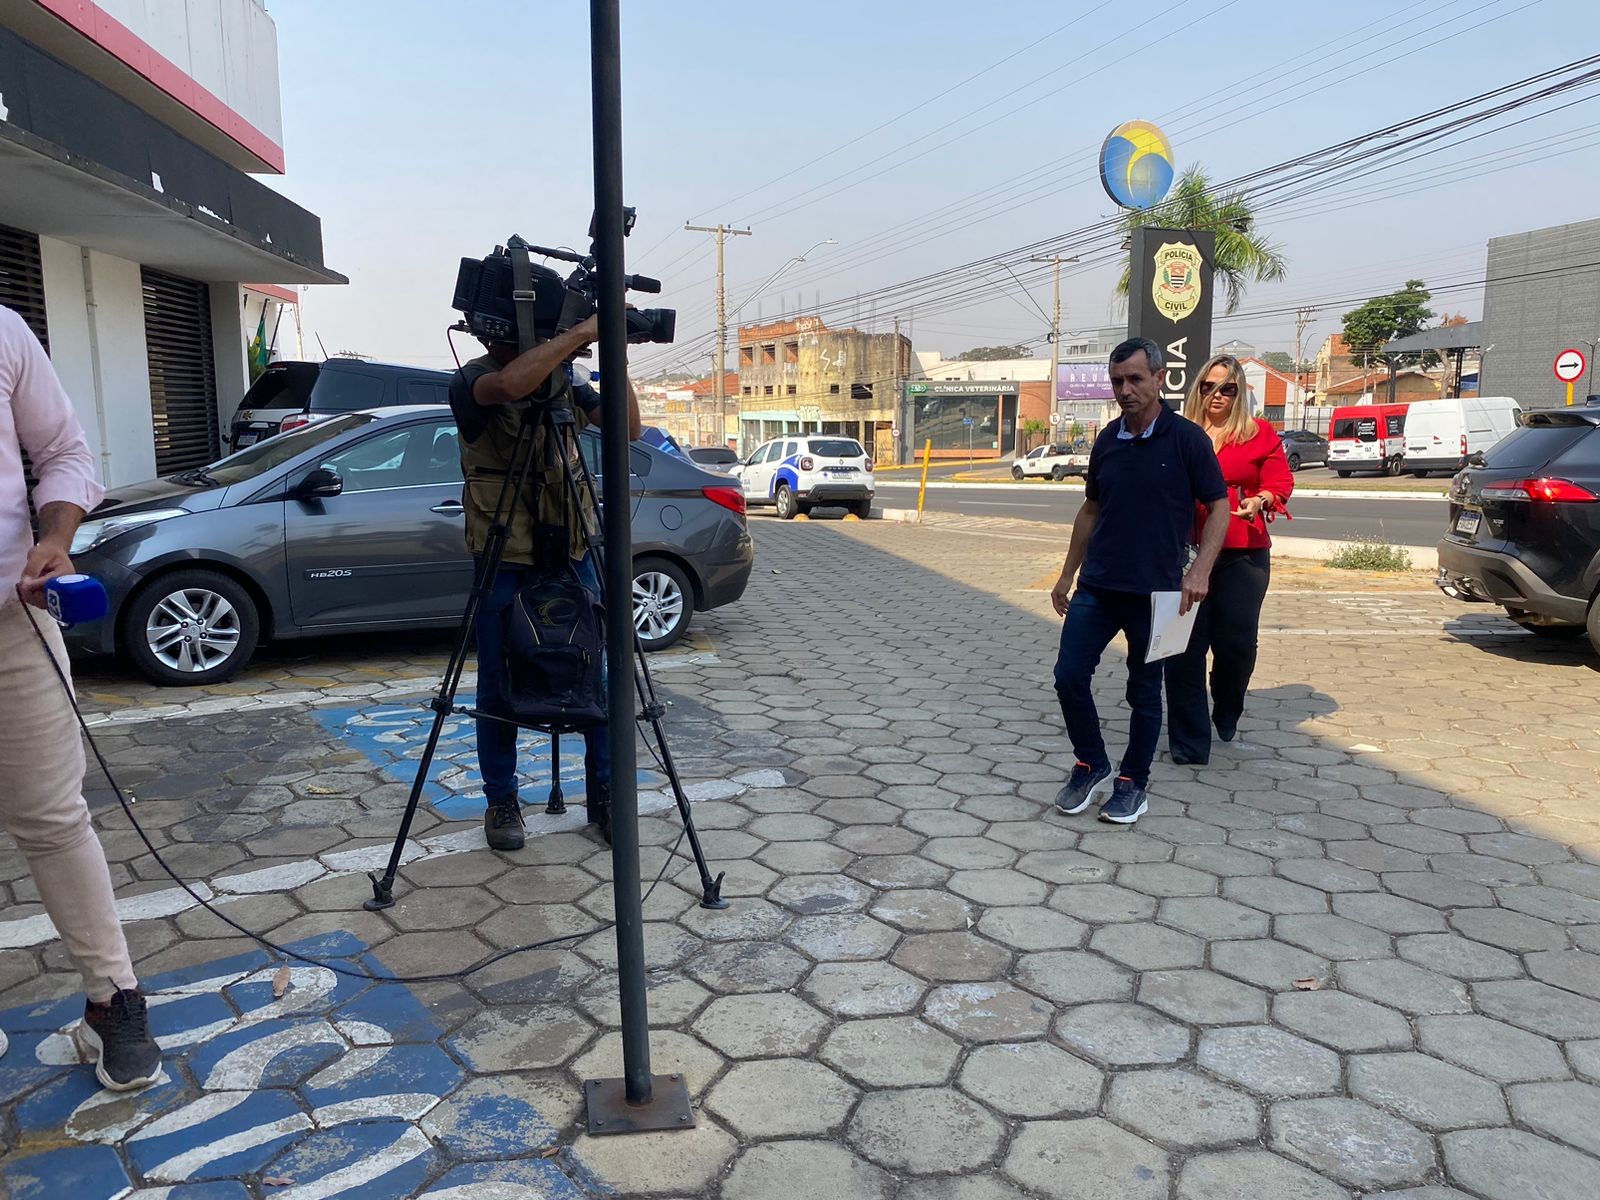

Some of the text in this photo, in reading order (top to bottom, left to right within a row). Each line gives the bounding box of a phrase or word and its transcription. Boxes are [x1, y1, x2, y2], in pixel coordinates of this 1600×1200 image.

[1165, 249, 1193, 261] POLÍCIA
[1165, 301, 1188, 311] CIVIL
[1159, 336, 1188, 416] LÍCIA
[965, 384, 1015, 392] VETERINÁRIA
[310, 569, 352, 578] HB20S
